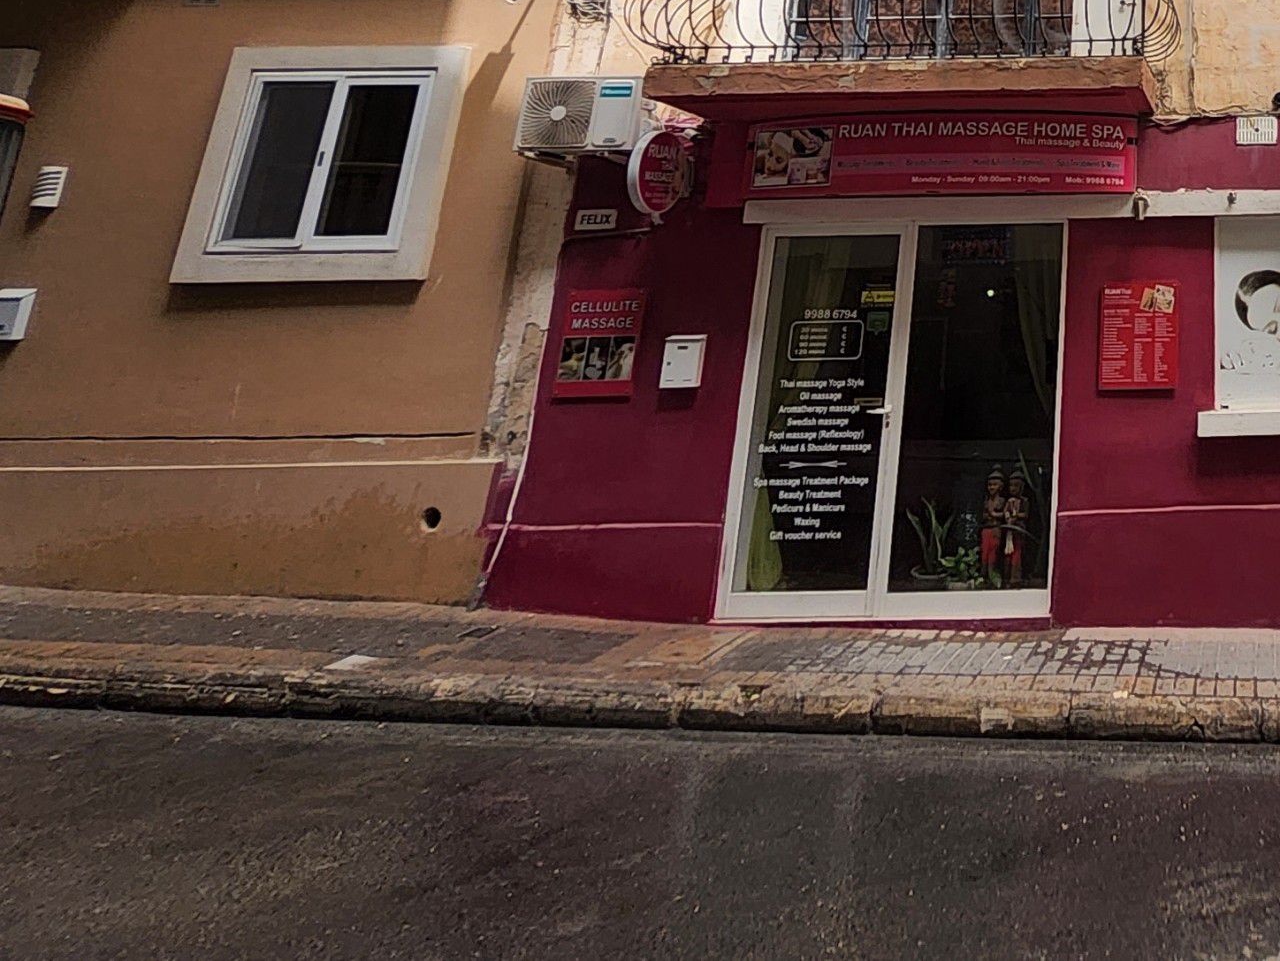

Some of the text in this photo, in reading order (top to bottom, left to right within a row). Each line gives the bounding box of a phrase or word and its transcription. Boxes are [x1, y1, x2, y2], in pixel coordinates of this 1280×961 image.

[839, 121, 1125, 140] RUAN THAI MASSAGE HOME SPA
[1015, 137, 1124, 150] Thai massage & Beauty
[911, 176, 941, 184] Monday
[947, 176, 975, 184] Sunday
[580, 214, 612, 225] FELIX
[571, 300, 640, 313] CELLULITE
[804, 309, 858, 319] 9988 6794
[571, 317, 634, 329] MASSAGE
[780, 378, 864, 389] Thai massage Yoga Style
[800, 392, 842, 401] Oil massage
[778, 405, 860, 414] Aromatherapy massage
[787, 417, 849, 426] Swedish massage
[768, 429, 864, 440] Foot massage (Reflexology)
[758, 444, 778, 453] Back,
[780, 444, 798, 452] Head
[807, 443, 838, 452] Shoulder
[840, 443, 871, 453] massage
[754, 476, 869, 487] Spa massage Treatment Package
[779, 490, 841, 500] Beauty Treatment
[772, 504, 803, 513] Pedicure
[812, 503, 845, 512] Manicure
[794, 517, 820, 527] Waxing
[770, 531, 841, 540] Gift voucher service
